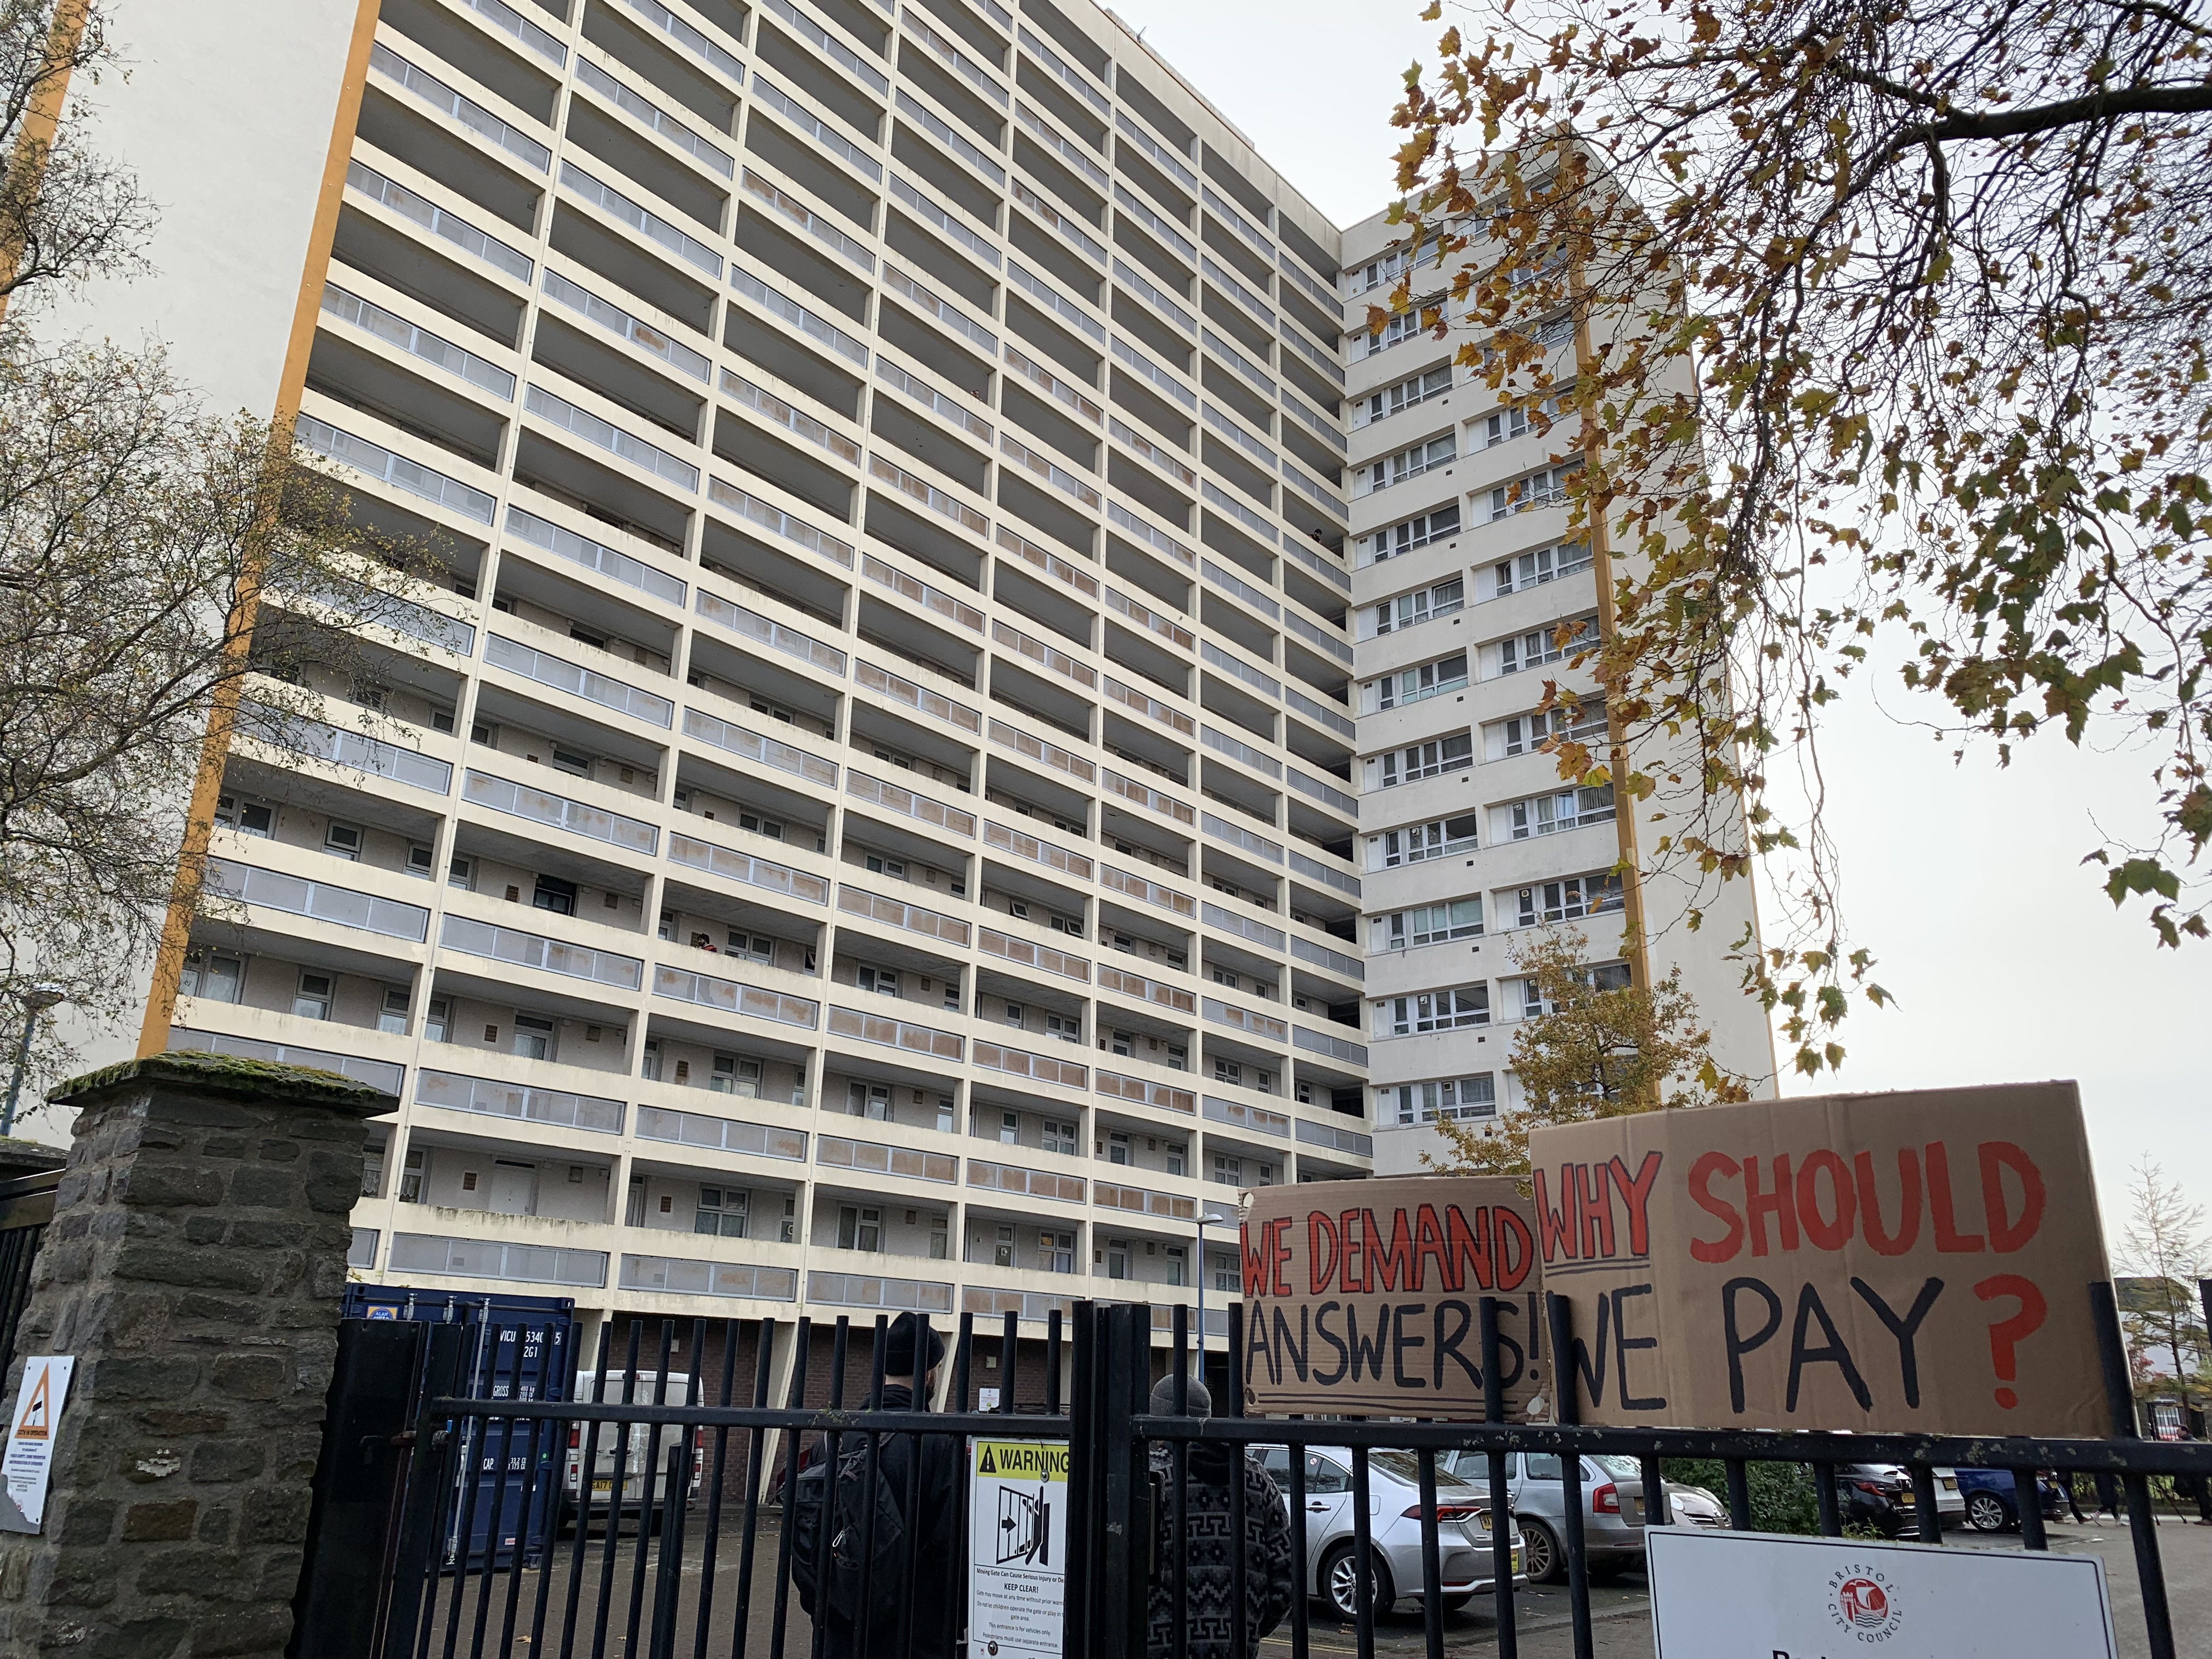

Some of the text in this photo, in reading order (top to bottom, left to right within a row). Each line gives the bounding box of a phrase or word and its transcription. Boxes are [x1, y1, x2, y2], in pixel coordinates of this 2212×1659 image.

[1533, 1141, 2047, 1263] WHY SHOULD
[1239, 1203, 1534, 1298] WE DEMAND
[500, 1330, 516, 1342] VICU
[555, 1333, 561, 1344] 5
[1245, 1292, 1540, 1390] ANSWERS!
[1545, 1283, 1667, 1410] WE
[1722, 1276, 1944, 1414] PAY
[493, 1385, 509, 1397] GROSS
[483, 1458, 494, 1470] CAP.
[1000, 1449, 1069, 1473] WARNING
[1004, 1583, 1039, 1593] KEEP CLEAR!
[1829, 1564, 1894, 1593] BRISTOL
[983, 1632, 1003, 1640] Pedestrians
[1828, 1604, 1902, 1643] CITY COUNCIL
